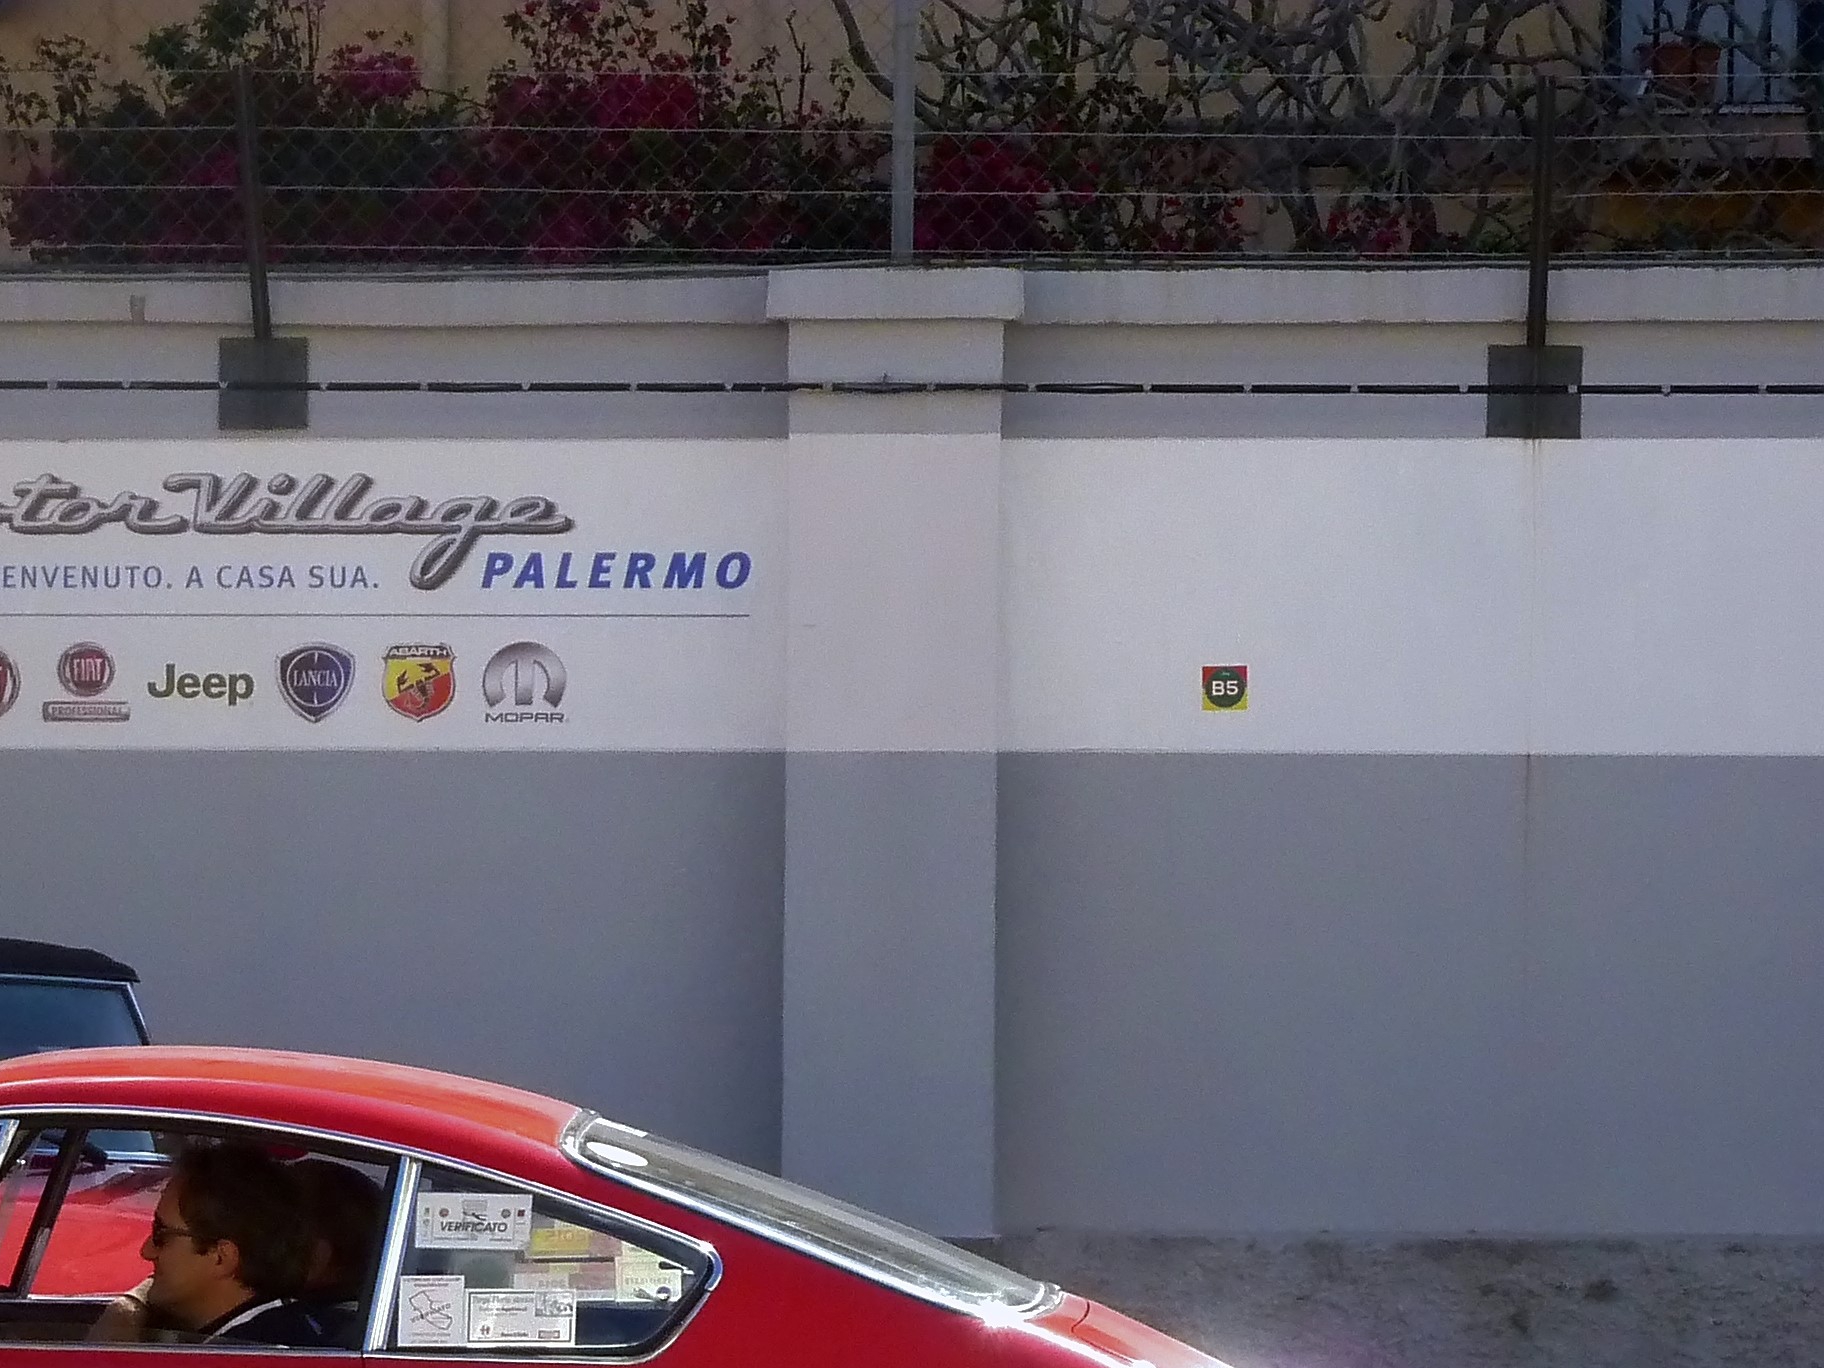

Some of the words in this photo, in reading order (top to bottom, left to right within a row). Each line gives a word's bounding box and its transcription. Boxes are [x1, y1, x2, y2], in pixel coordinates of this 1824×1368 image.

[185, 564, 205, 590] A
[216, 564, 297, 590] CASA
[308, 564, 380, 590] SUA.
[480, 550, 753, 590] PALERMO
[388, 646, 448, 657] ABARTH
[73, 657, 104, 682] FIAT
[147, 662, 256, 707] Jeep
[292, 670, 339, 687] LANCIA
[1211, 680, 1239, 696] B5
[484, 712, 565, 724] MOPAR
[440, 1220, 508, 1233] VERIFICATO
